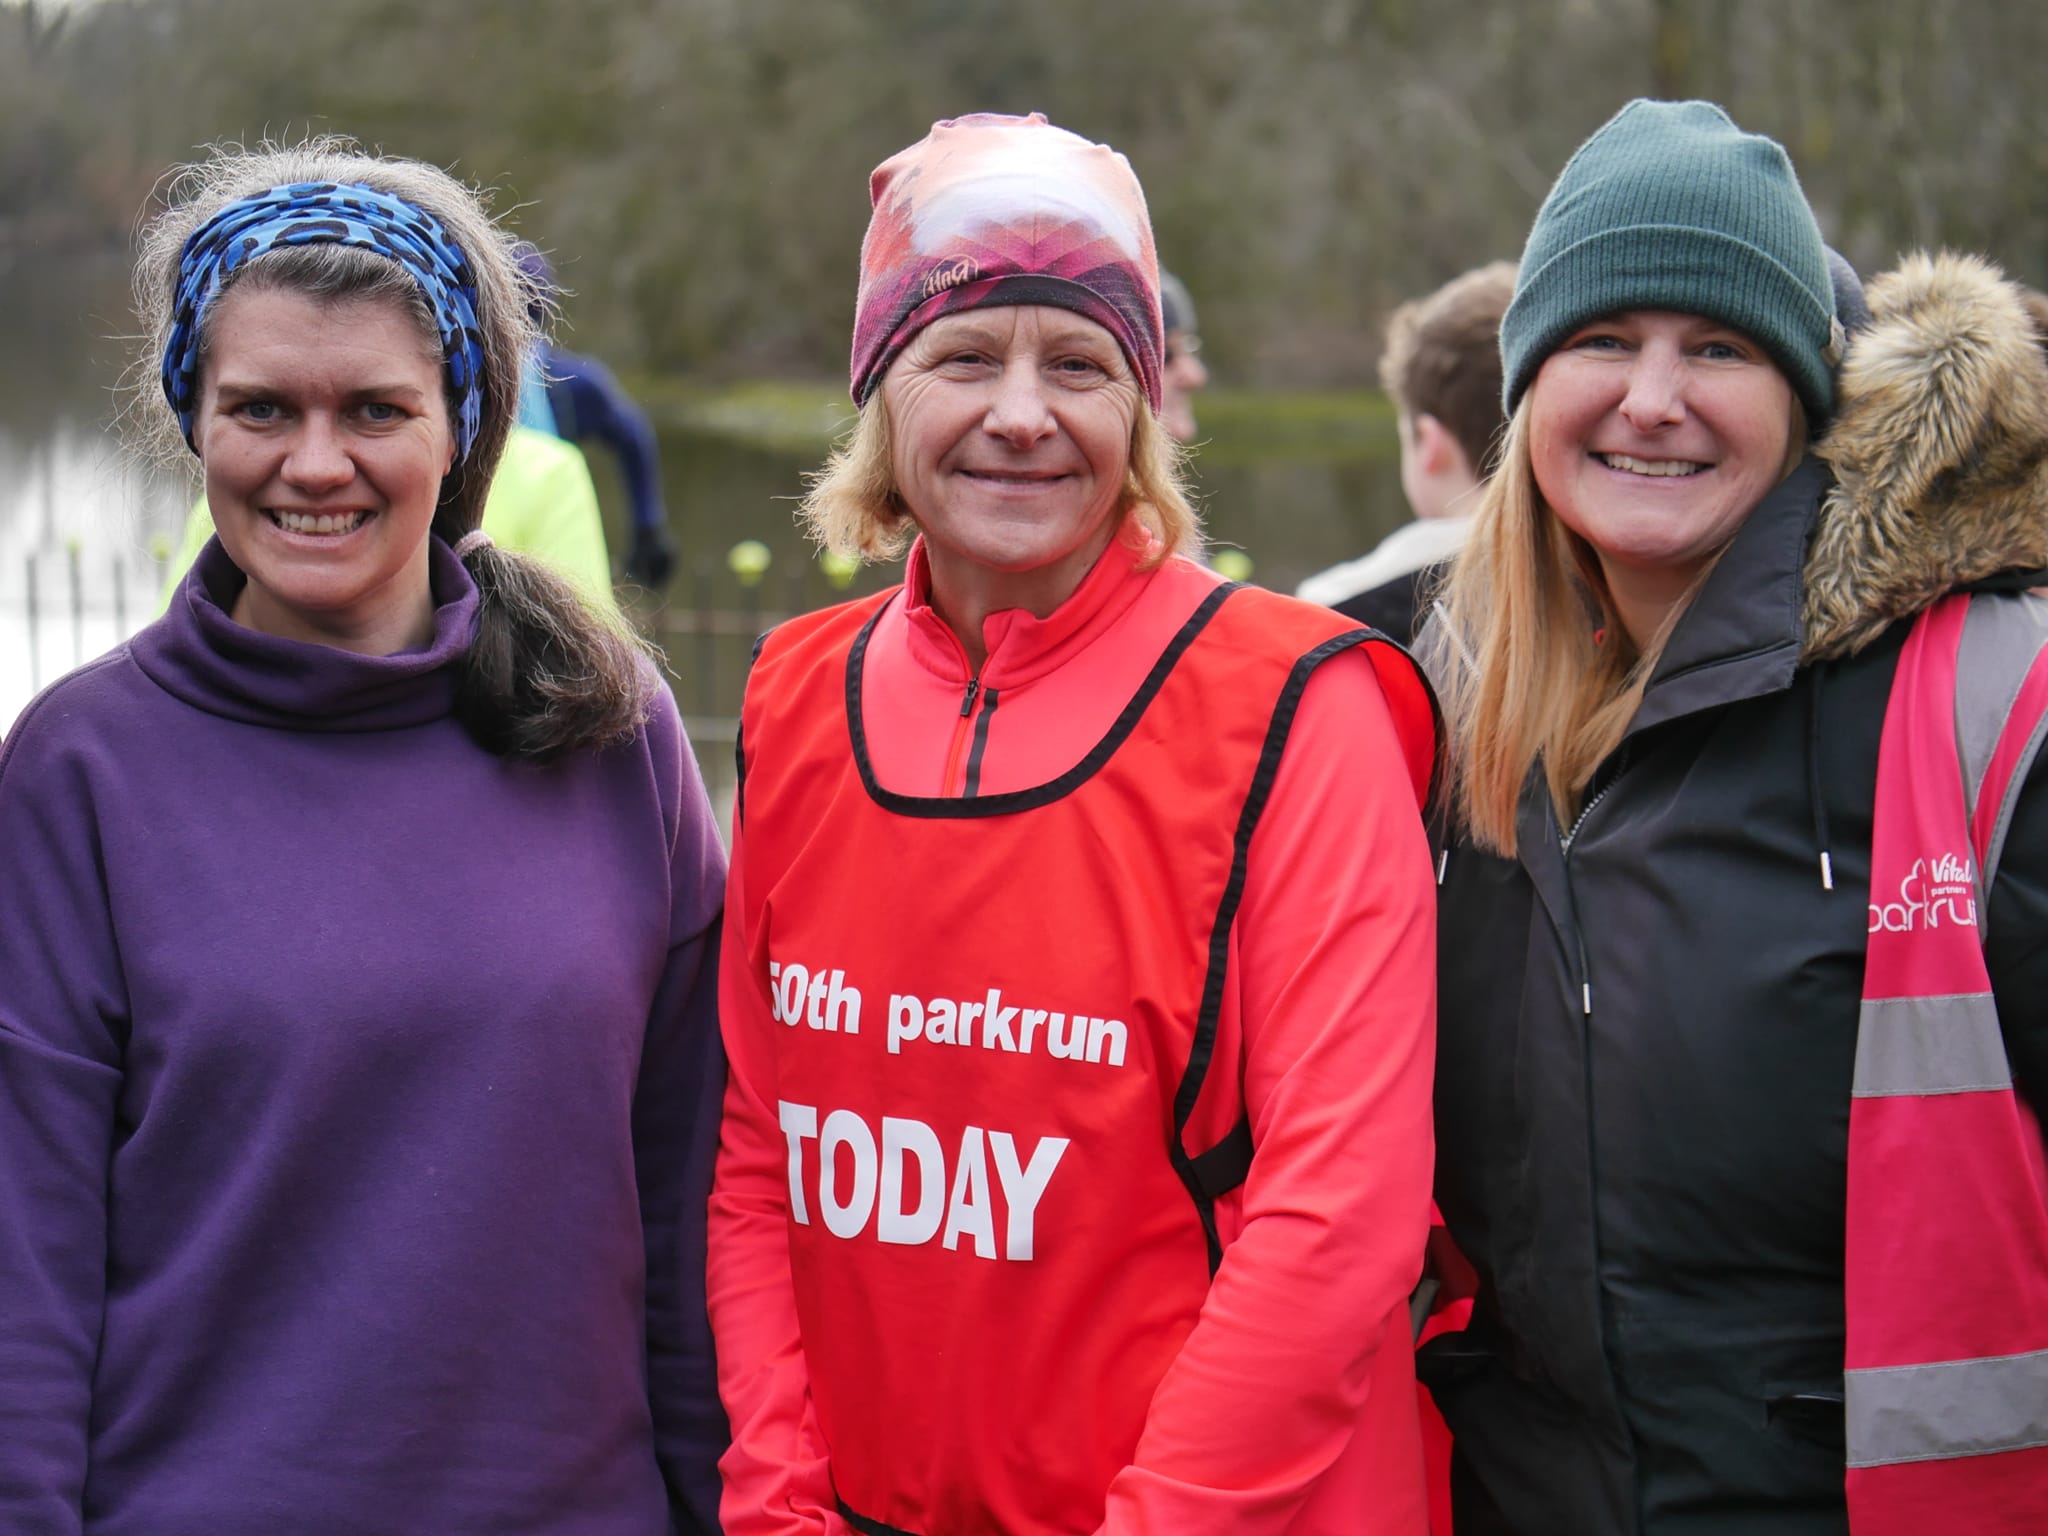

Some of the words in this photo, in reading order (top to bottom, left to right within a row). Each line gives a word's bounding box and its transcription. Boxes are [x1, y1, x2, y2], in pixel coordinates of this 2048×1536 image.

[1931, 886, 1967, 898] partners
[887, 989, 1128, 1067] parkrun
[778, 1099, 1071, 1261] TODAY
